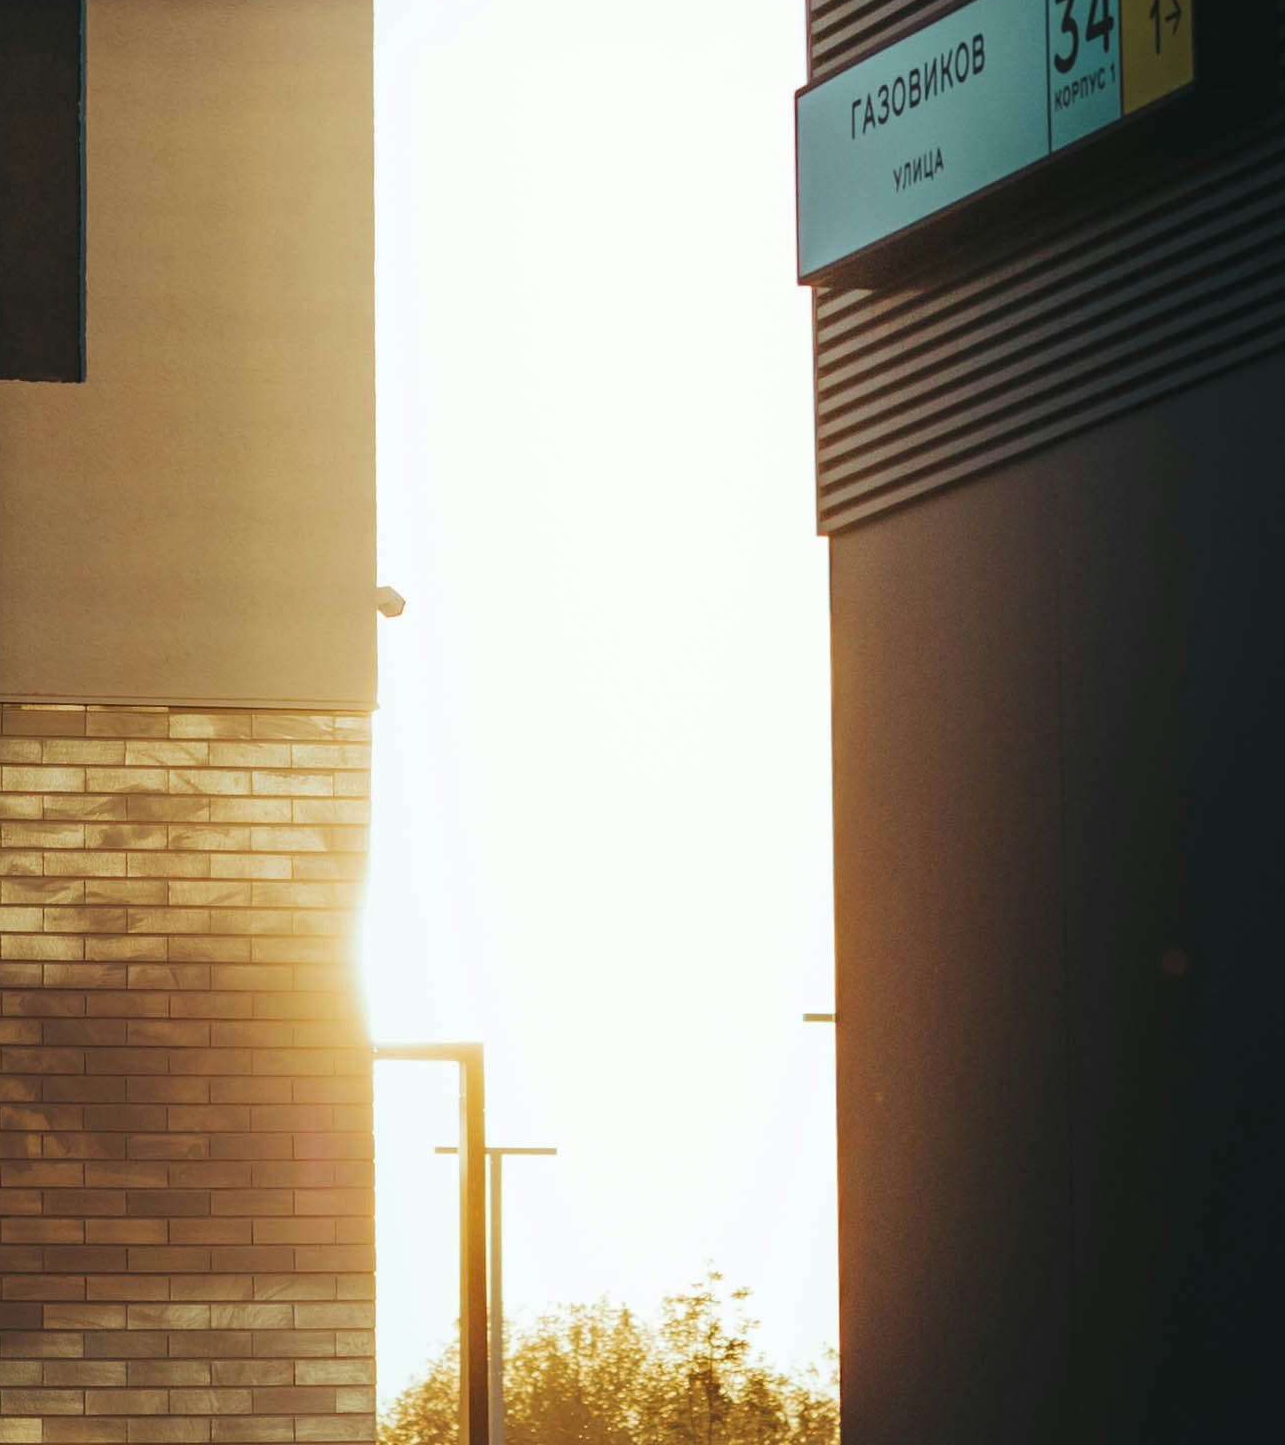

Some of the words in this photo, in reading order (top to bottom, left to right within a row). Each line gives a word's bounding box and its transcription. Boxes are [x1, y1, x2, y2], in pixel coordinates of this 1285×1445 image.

[850, 32, 987, 141] ГАЗОВИКОВ
[1053, 66, 1107, 112] КОРПУС
[1109, 62, 1116, 84] 1
[892, 147, 945, 194] УЛИЦА
